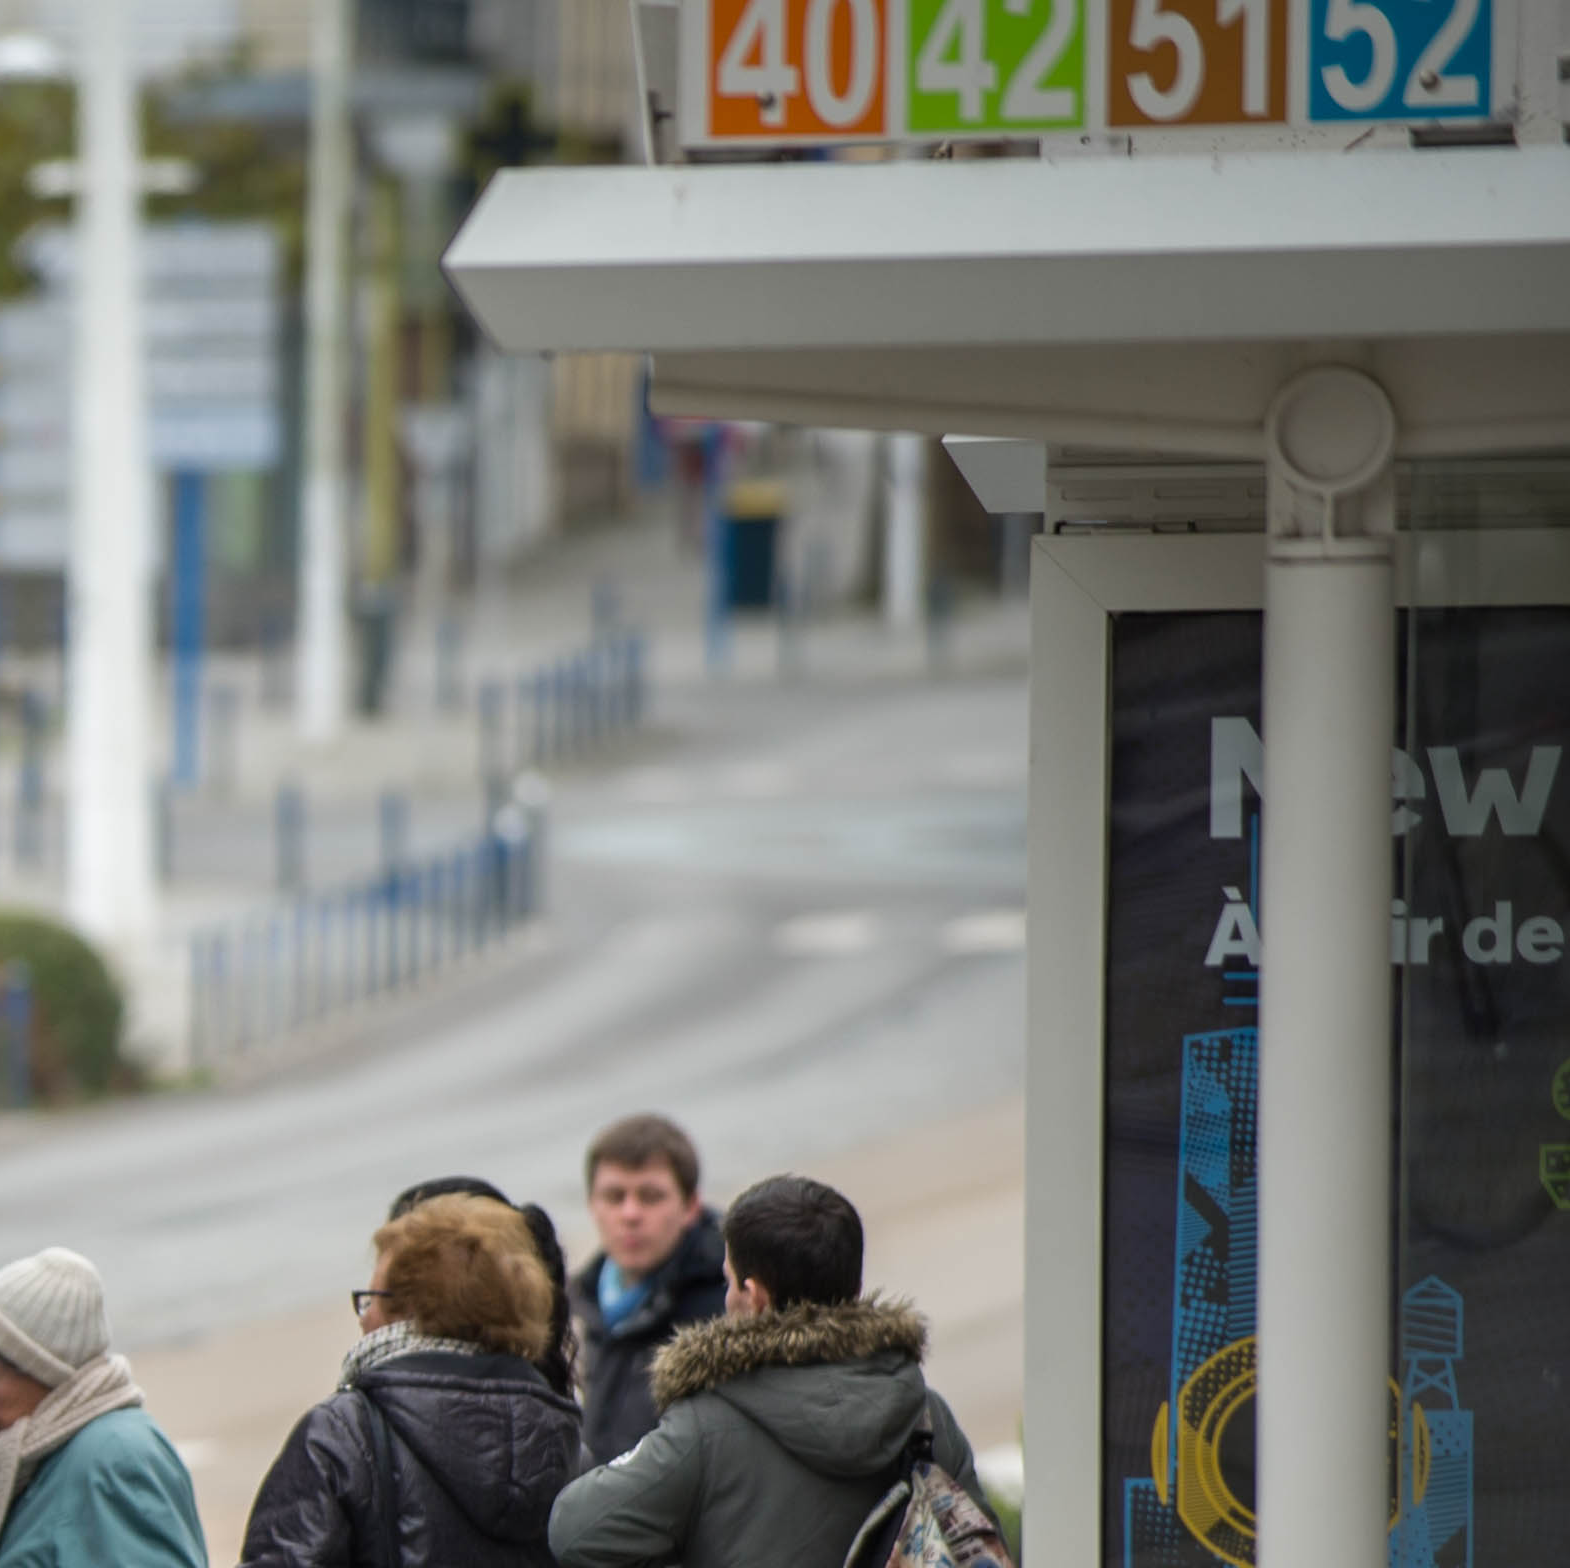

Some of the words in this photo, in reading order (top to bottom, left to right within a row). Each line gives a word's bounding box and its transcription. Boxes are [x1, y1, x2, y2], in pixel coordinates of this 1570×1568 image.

[718, 0, 878, 127] 40
[915, 0, 1081, 121] 42
[1126, 0, 1273, 120] 51
[1321, 0, 1483, 111] 52
[1462, 900, 1566, 965] de
